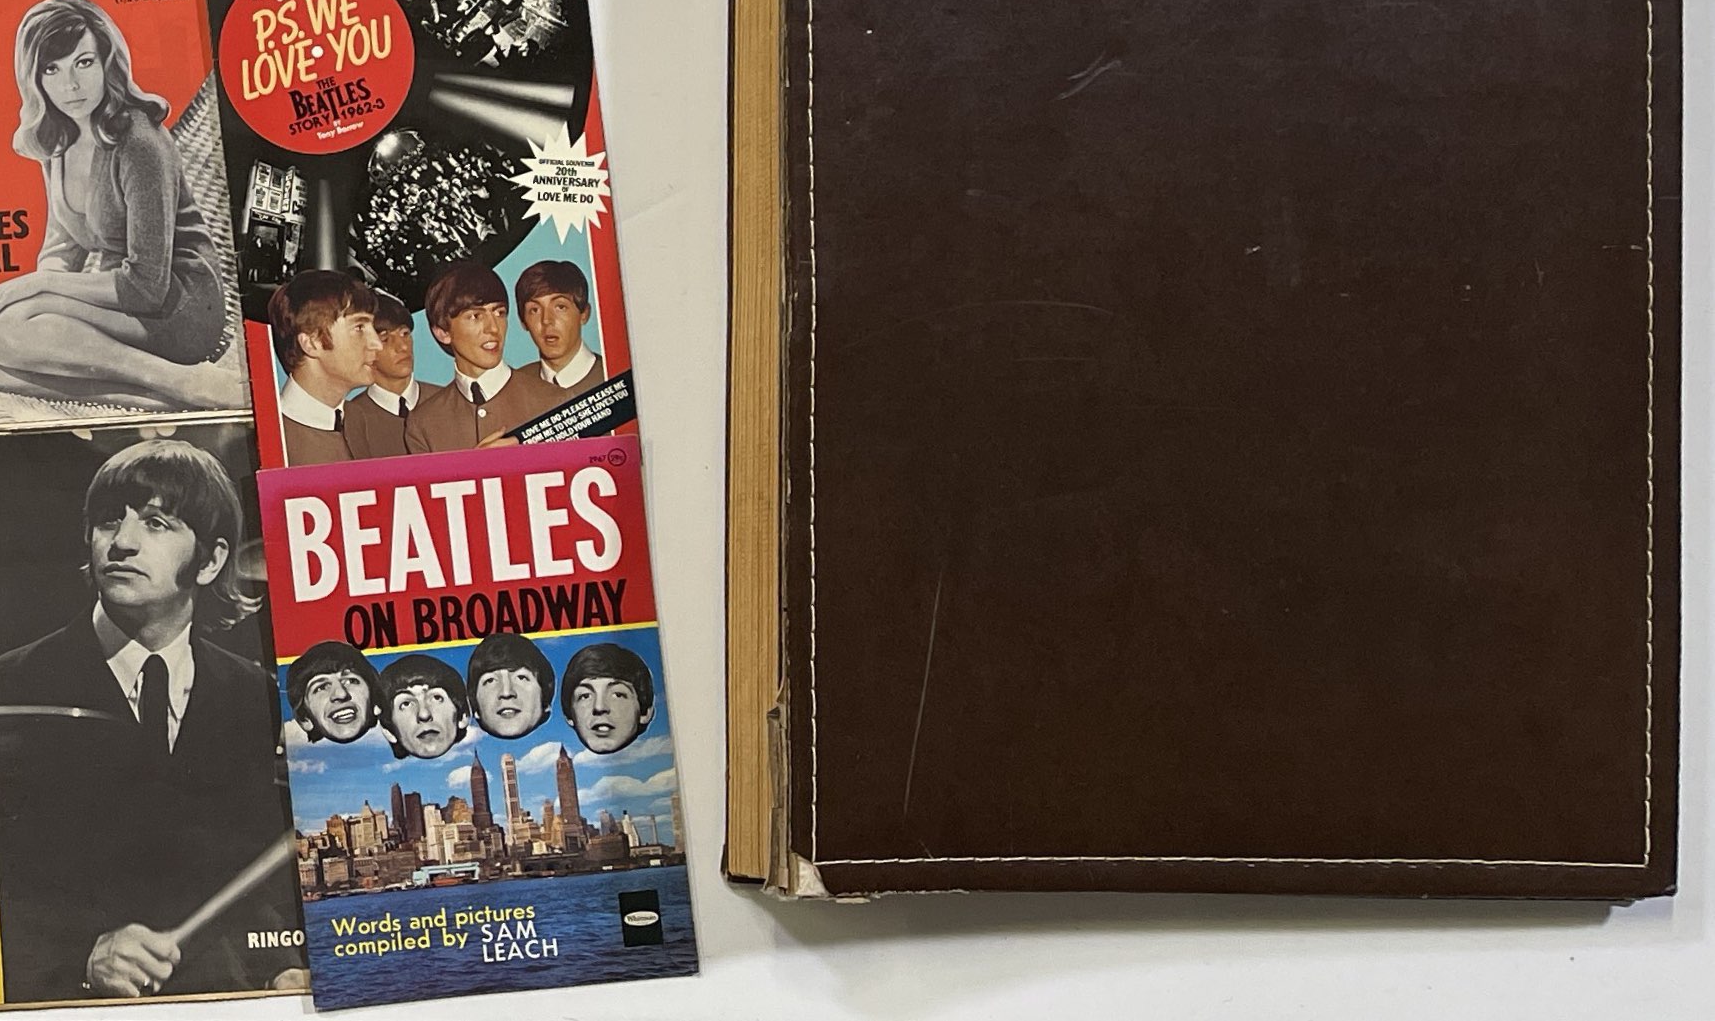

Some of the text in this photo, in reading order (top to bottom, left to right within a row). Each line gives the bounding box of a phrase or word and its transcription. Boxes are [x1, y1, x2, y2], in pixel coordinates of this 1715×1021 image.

[253, 1, 304, 53] P.S.
[242, 15, 392, 100] LOVE YOU
[533, 175, 600, 188] ANNIVERSARY
[284, 466, 622, 602] BEATLES
[345, 579, 626, 649] ON BROADWAY
[332, 905, 535, 937] Words and pictures
[481, 920, 537, 943] SAM
[247, 930, 305, 949] RINGO
[334, 930, 469, 957] compiled by
[483, 939, 558, 963] LEACH
